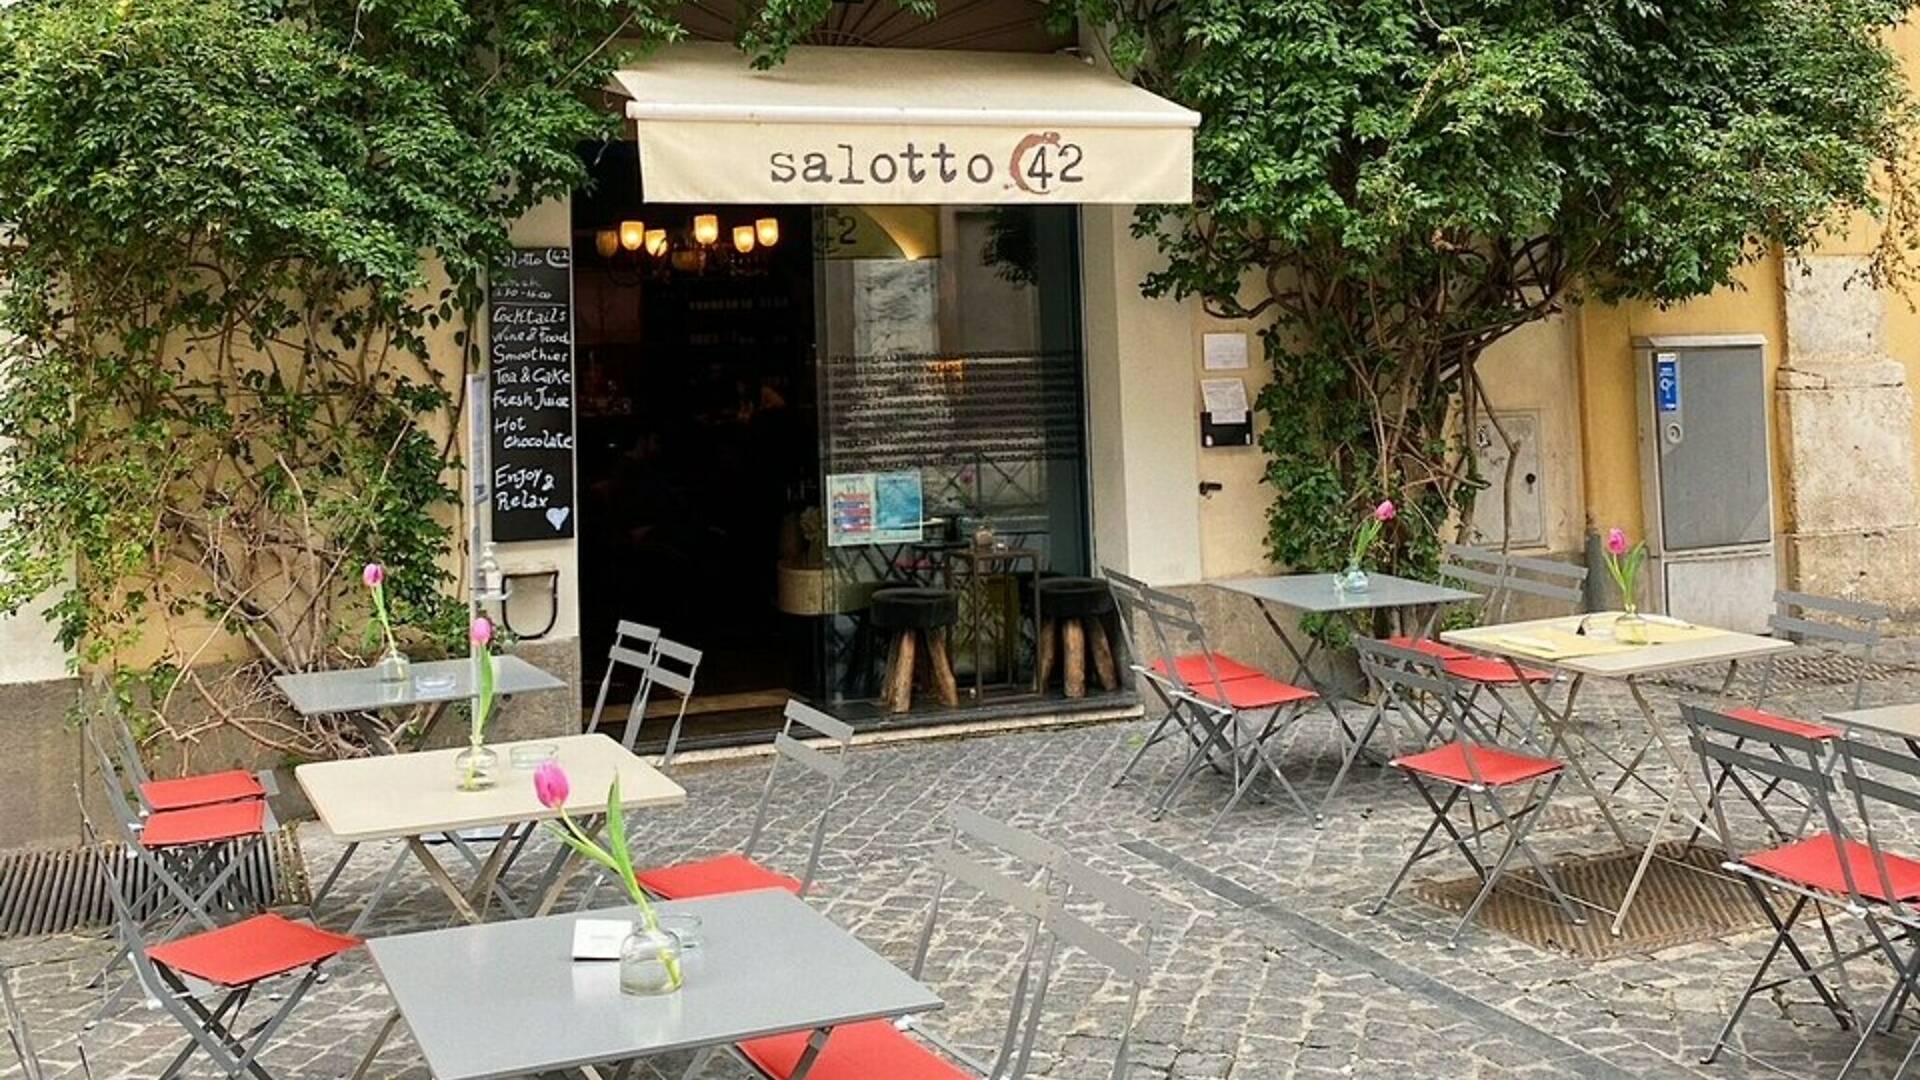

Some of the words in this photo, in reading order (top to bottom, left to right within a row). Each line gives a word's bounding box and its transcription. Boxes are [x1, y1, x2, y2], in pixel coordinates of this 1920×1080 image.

[770, 142, 994, 184] salotto
[1027, 143, 1084, 190] 42
[493, 306, 567, 325] Cocktails
[526, 326, 537, 341] &
[539, 326, 570, 344] Food
[493, 343, 569, 364] Smoothies
[493, 366, 517, 385] Tea
[520, 366, 530, 383] &
[532, 367, 571, 385] Cake
[494, 388, 533, 410] Fresh
[533, 386, 570, 411] Juice
[494, 416, 527, 434] Hot
[495, 463, 543, 490] Enjoy
[541, 473, 555, 490] &
[496, 489, 549, 511] Relax
